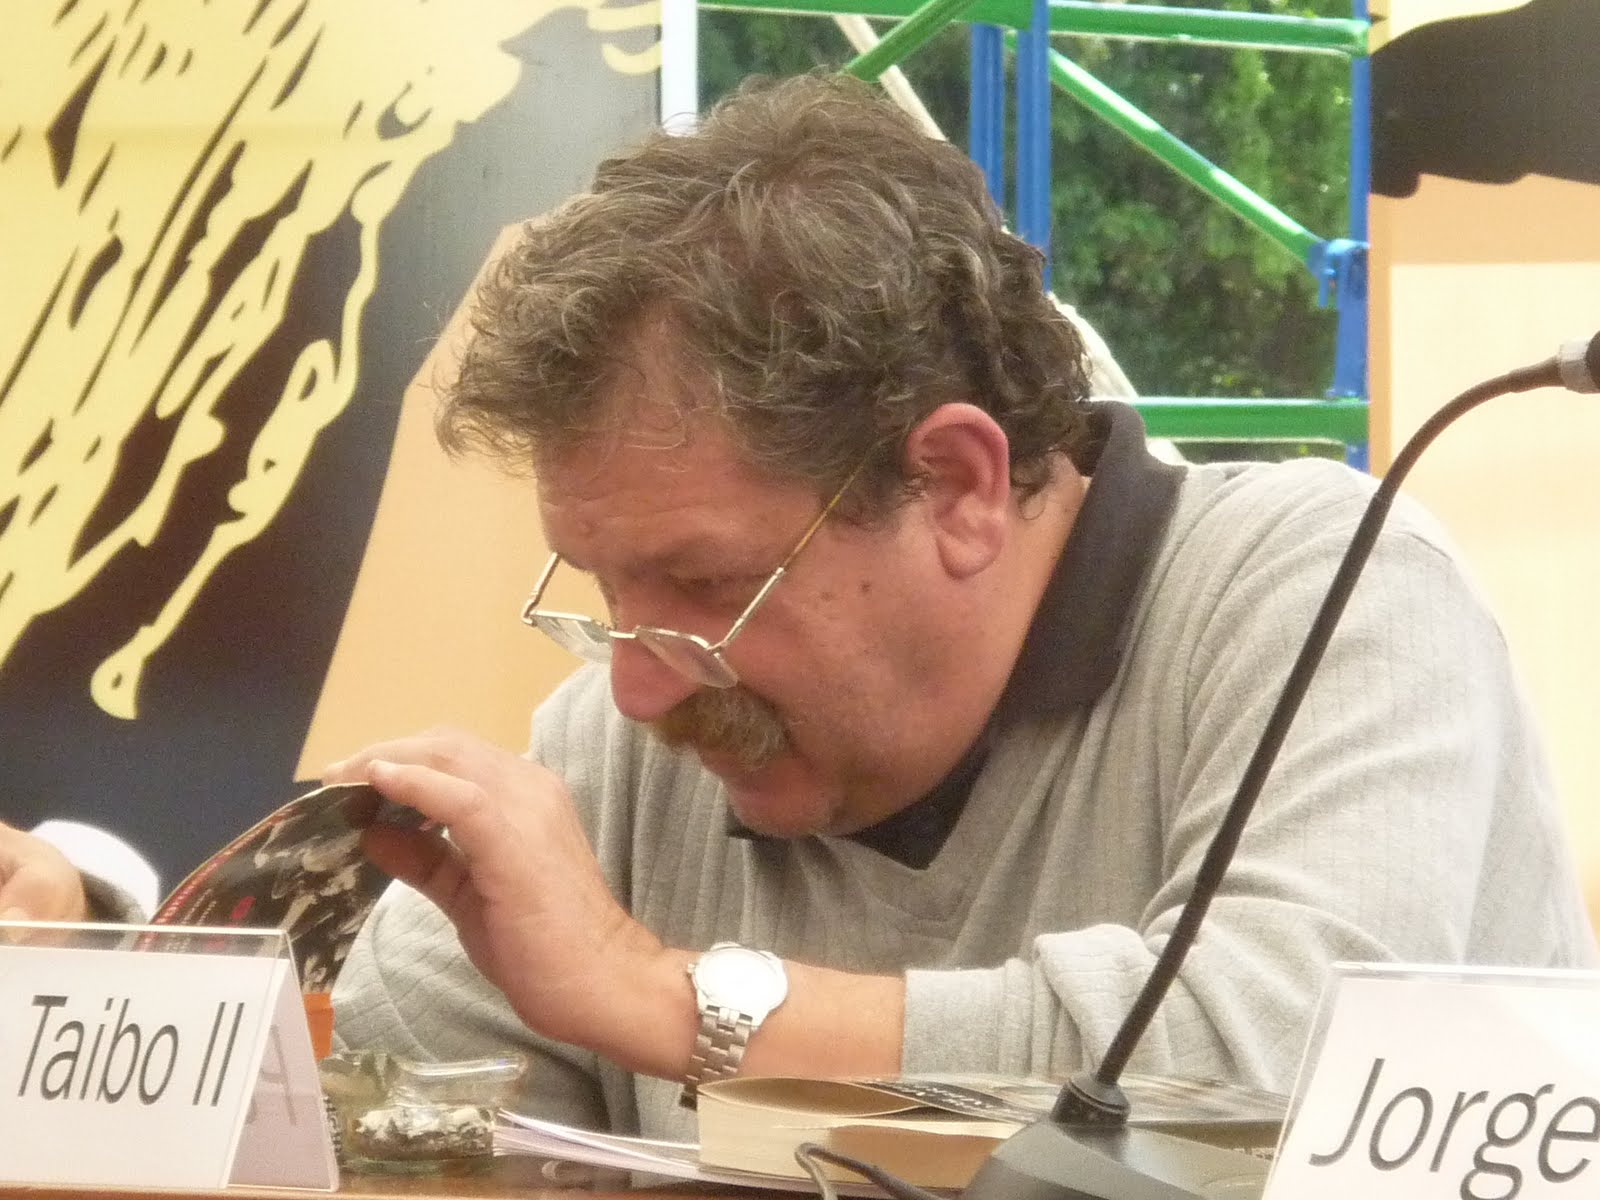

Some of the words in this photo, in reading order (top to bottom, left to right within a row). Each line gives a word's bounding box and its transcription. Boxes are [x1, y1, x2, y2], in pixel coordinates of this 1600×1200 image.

[18, 995, 180, 1106] Taibo
[192, 1002, 245, 1108] II
[1308, 1057, 1600, 1200] Jorge
